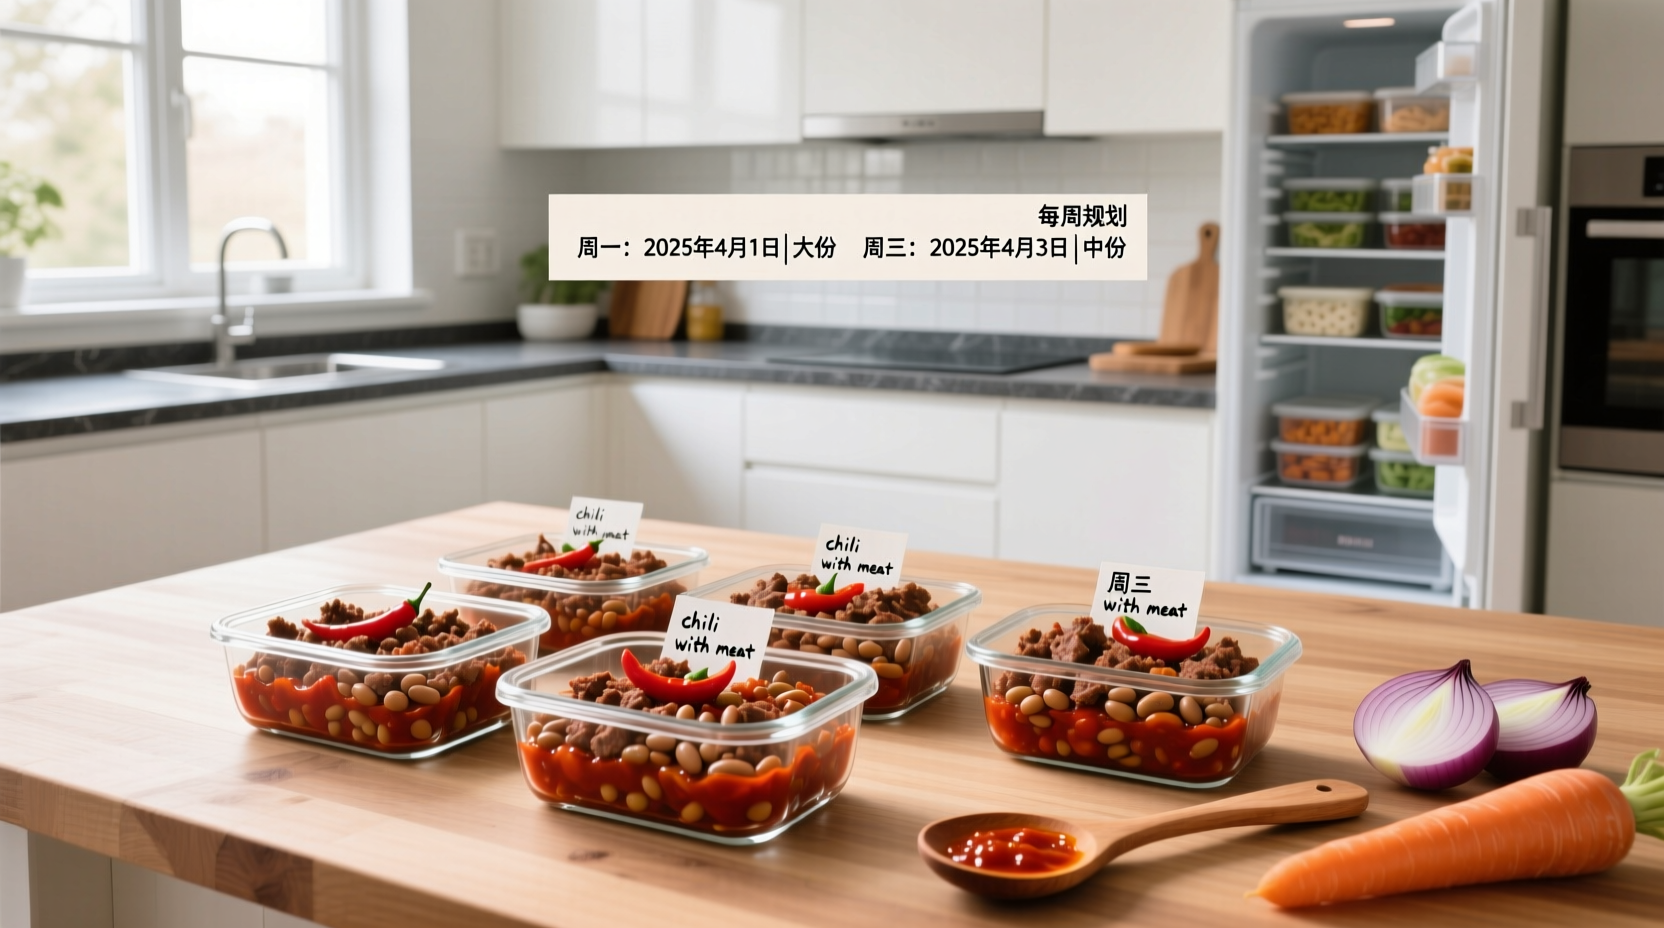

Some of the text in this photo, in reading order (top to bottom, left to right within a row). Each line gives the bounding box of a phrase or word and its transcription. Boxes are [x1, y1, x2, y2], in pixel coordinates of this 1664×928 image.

[576, 506, 605, 521] chili
[826, 534, 860, 553] chili
[821, 556, 893, 576] with meat
[1107, 571, 1152, 595] 周三
[1103, 596, 1188, 618] with meat
[681, 611, 720, 633] chili
[675, 636, 756, 660] with meat
